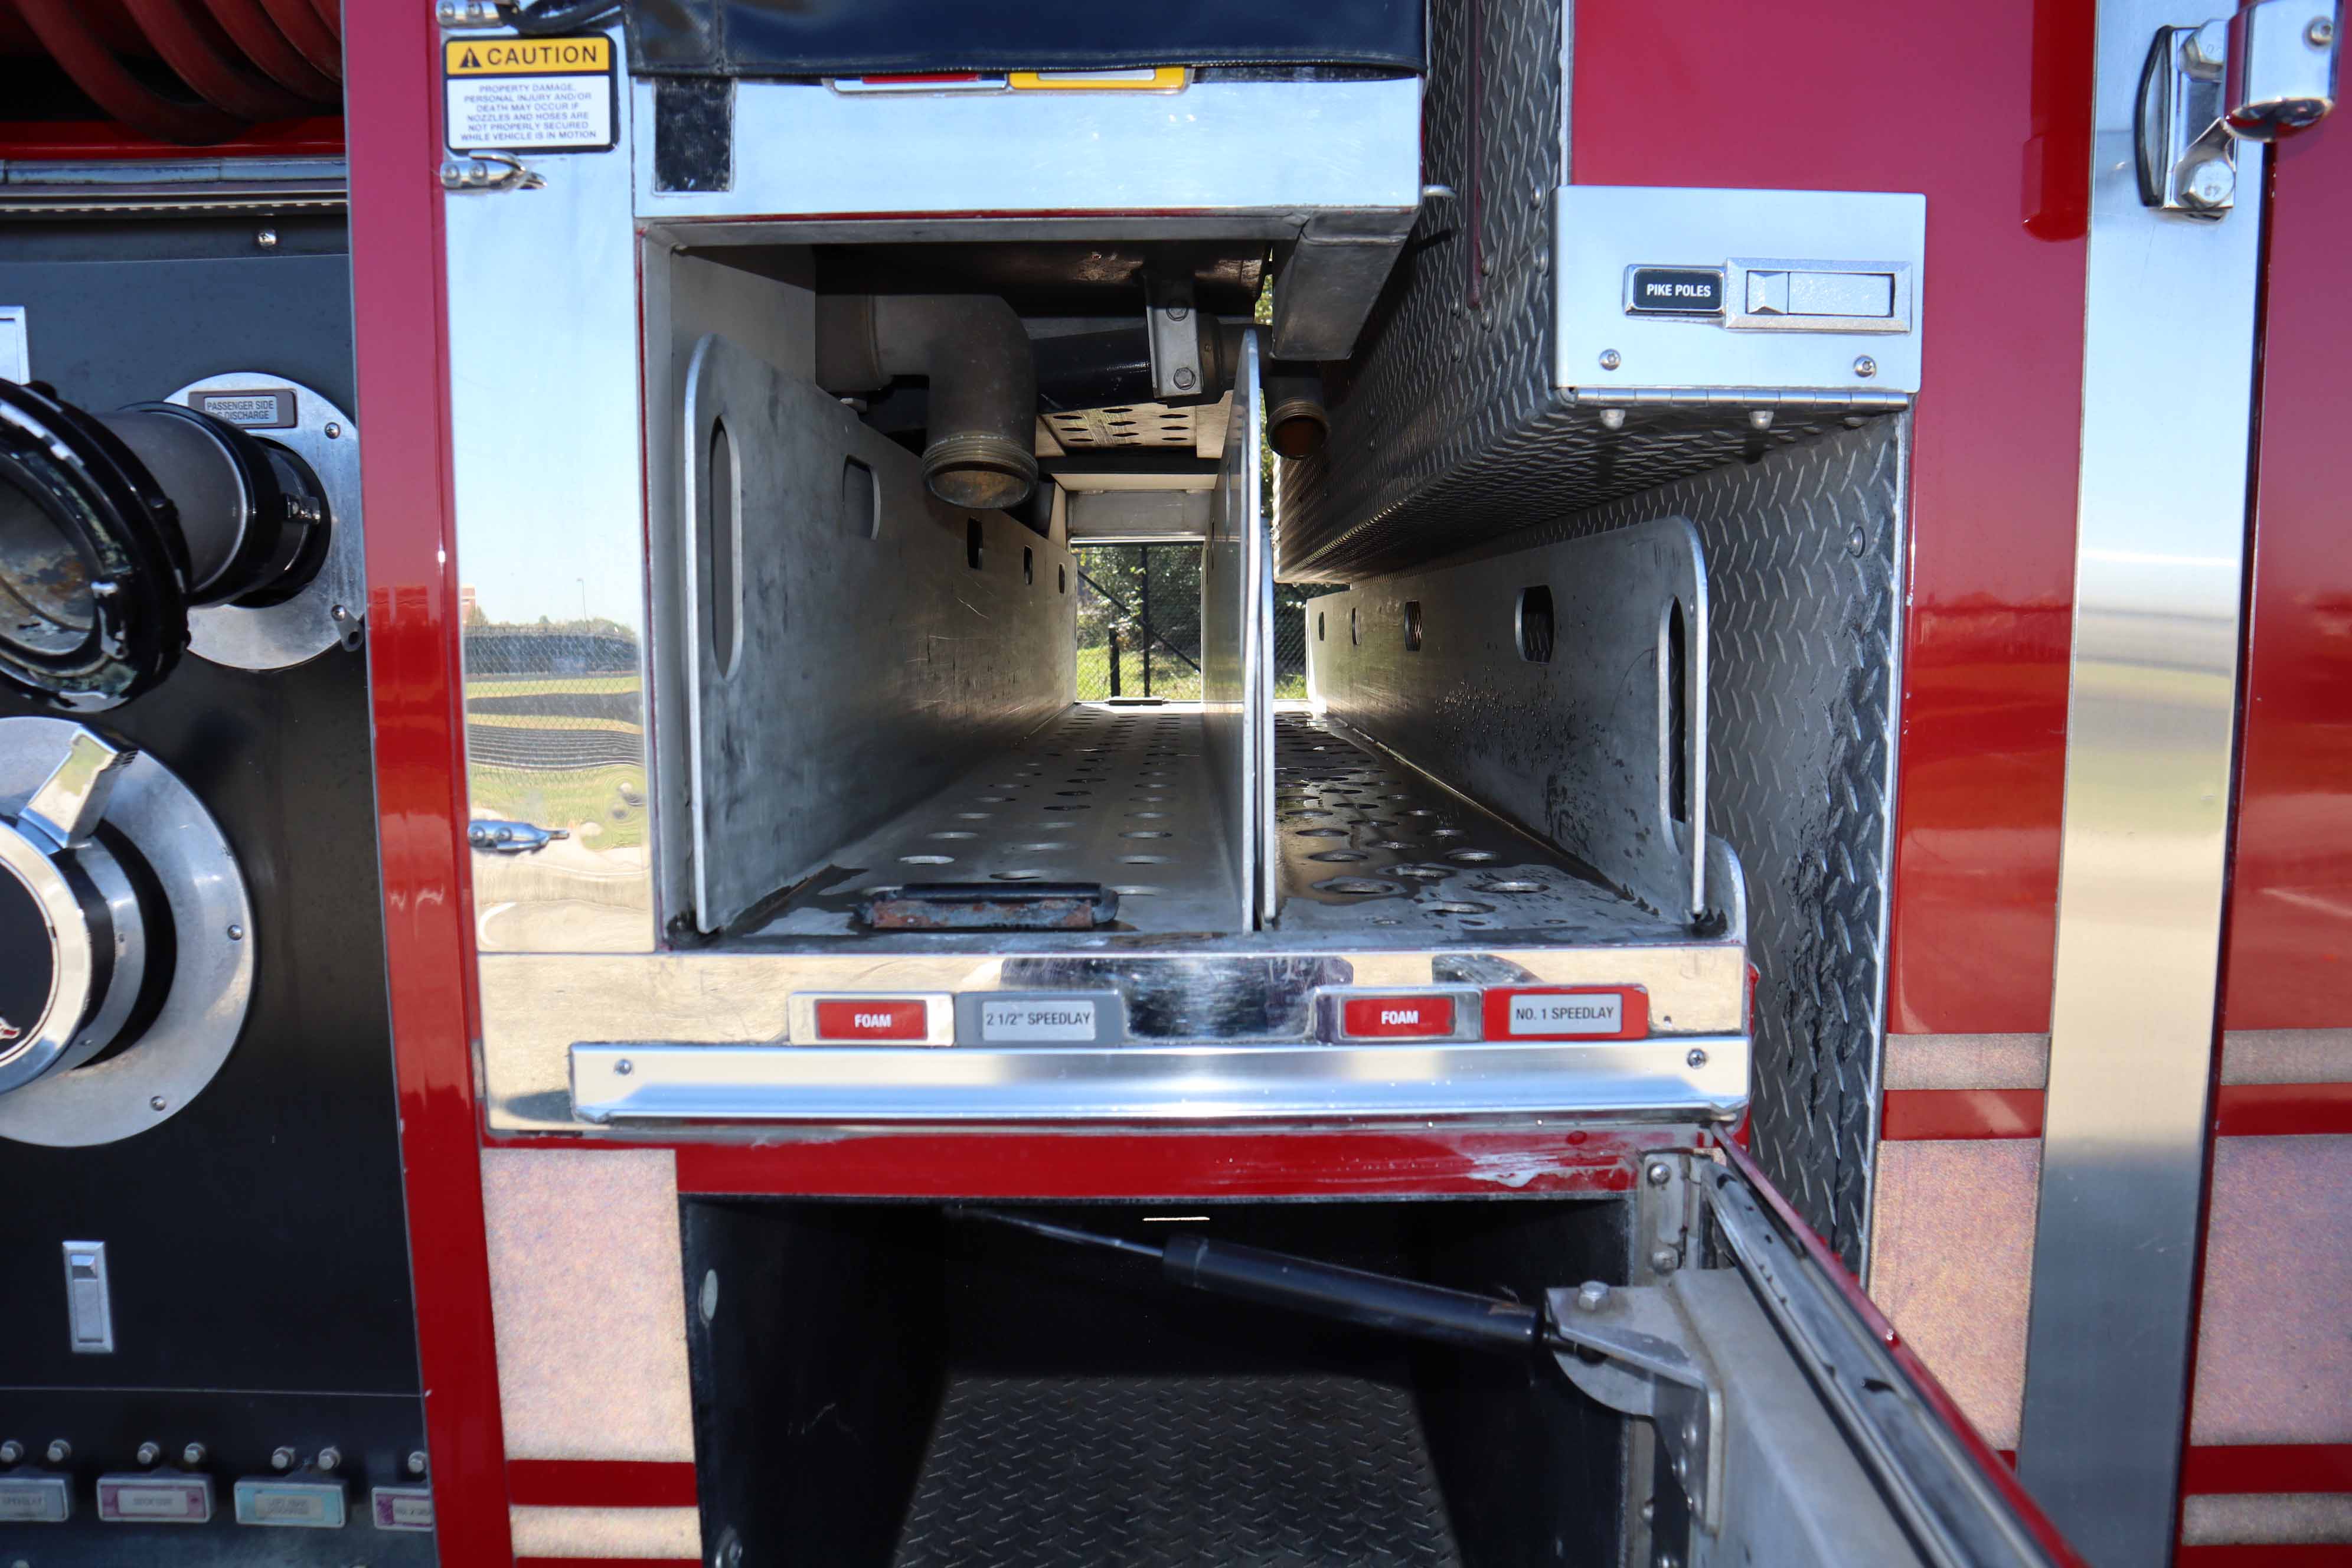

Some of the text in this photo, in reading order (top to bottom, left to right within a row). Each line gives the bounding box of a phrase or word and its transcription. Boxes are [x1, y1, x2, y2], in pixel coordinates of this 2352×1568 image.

[488, 46, 596, 65] CAUTION
[479, 84, 530, 93] PROPERTY
[464, 94, 514, 103] PERSONAL
[477, 104, 508, 112] DEATH
[534, 103, 568, 111] OCCUR
[468, 113, 511, 122] NOZZLES
[535, 112, 567, 120] HOSES
[571, 111, 589, 119] ARE
[469, 121, 589, 132] NOT PROPERLY SECURED
[461, 133, 489, 142] WHILE
[493, 132, 532, 141] VEHICLE
[547, 131, 556, 139] IN
[559, 130, 596, 139] MOTION
[1647, 283, 1711, 297] PIKE POLES
[207, 400, 274, 411] PASSENGER SIDE
[226, 410, 270, 420] DISCHARGE
[986, 1013, 994, 1025] 2
[1028, 1012, 1091, 1025] SPEEDLAY
[1381, 1010, 1419, 1025] FOAM
[1516, 1007, 1614, 1020] NO. 1 SPEEDLAY
[854, 1013, 891, 1028] FOAM
